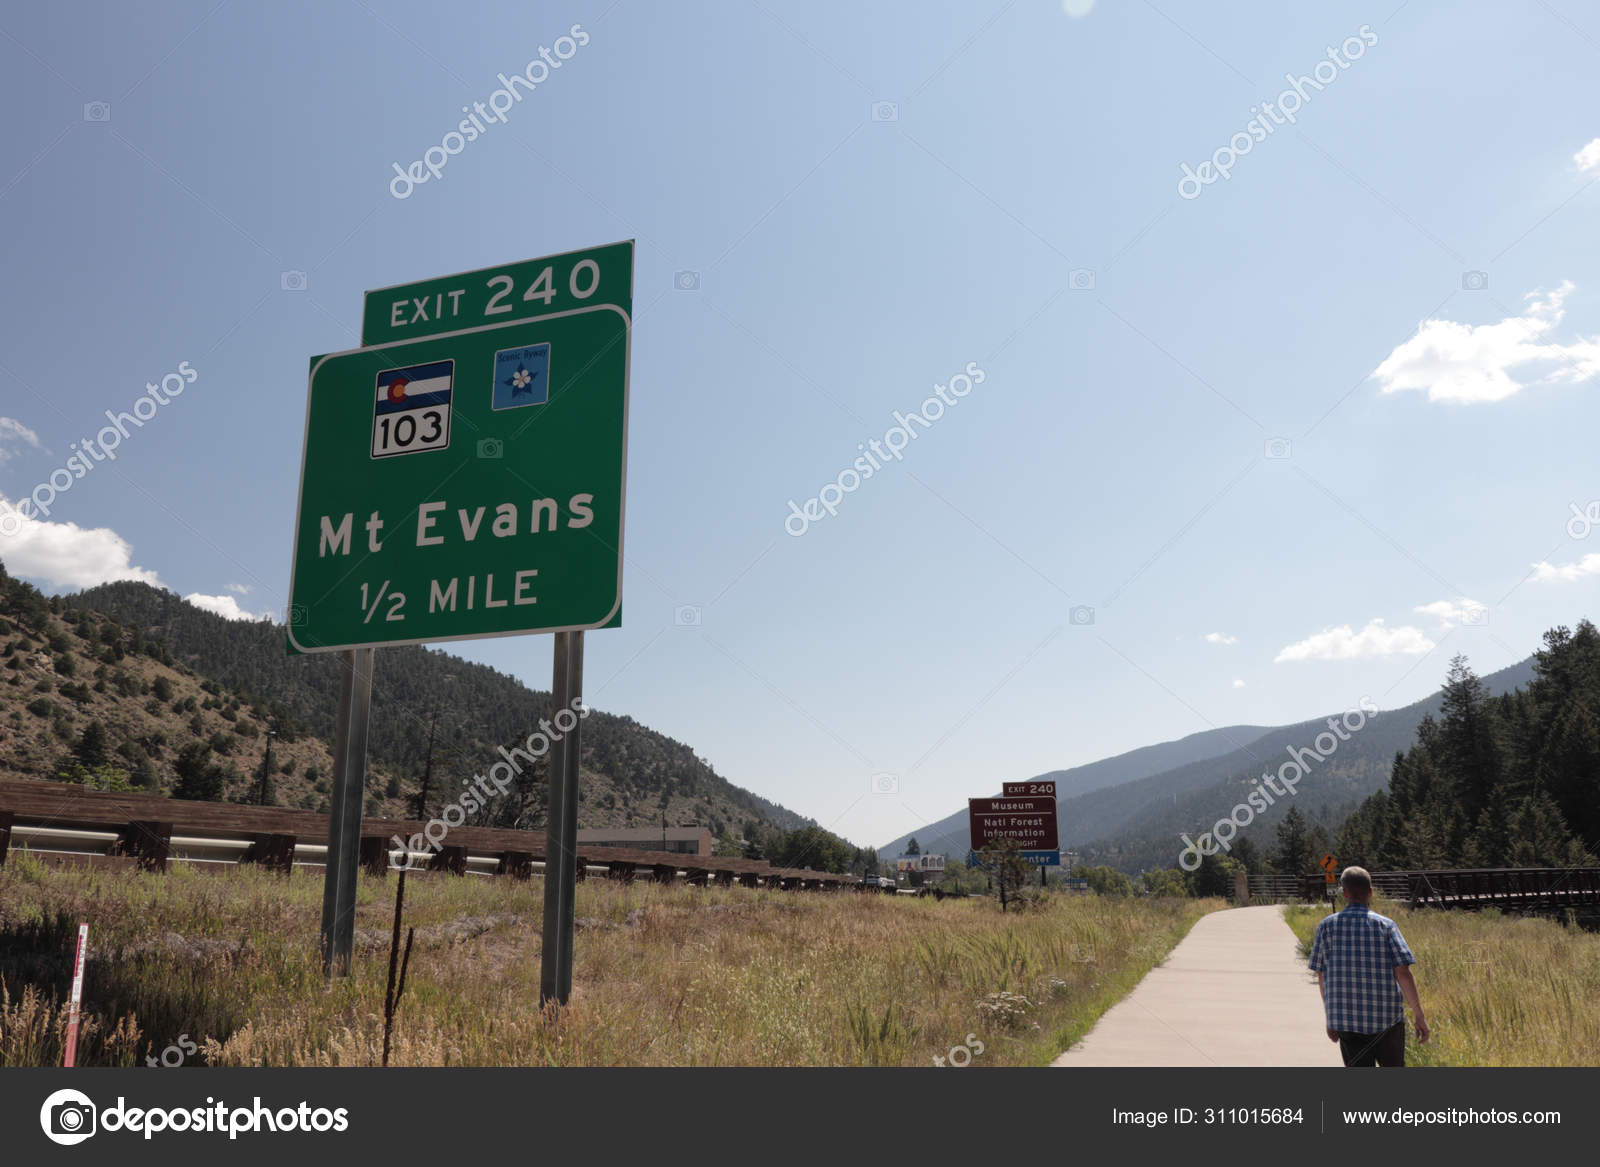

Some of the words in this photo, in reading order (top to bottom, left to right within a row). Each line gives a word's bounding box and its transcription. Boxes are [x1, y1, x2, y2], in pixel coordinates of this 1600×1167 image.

[390, 288, 466, 328] EXIT
[483, 258, 600, 317] 240
[498, 351, 521, 362] Scenic
[524, 349, 546, 360] Byway
[380, 411, 443, 450] 103
[318, 509, 385, 558] Mt
[416, 492, 595, 547] Evans
[429, 569, 539, 614] MILE
[1029, 784, 1054, 794] 240
[991, 802, 1034, 810] Museum
[1010, 818, 1043, 826] Forest
[983, 829, 1045, 838] Information
